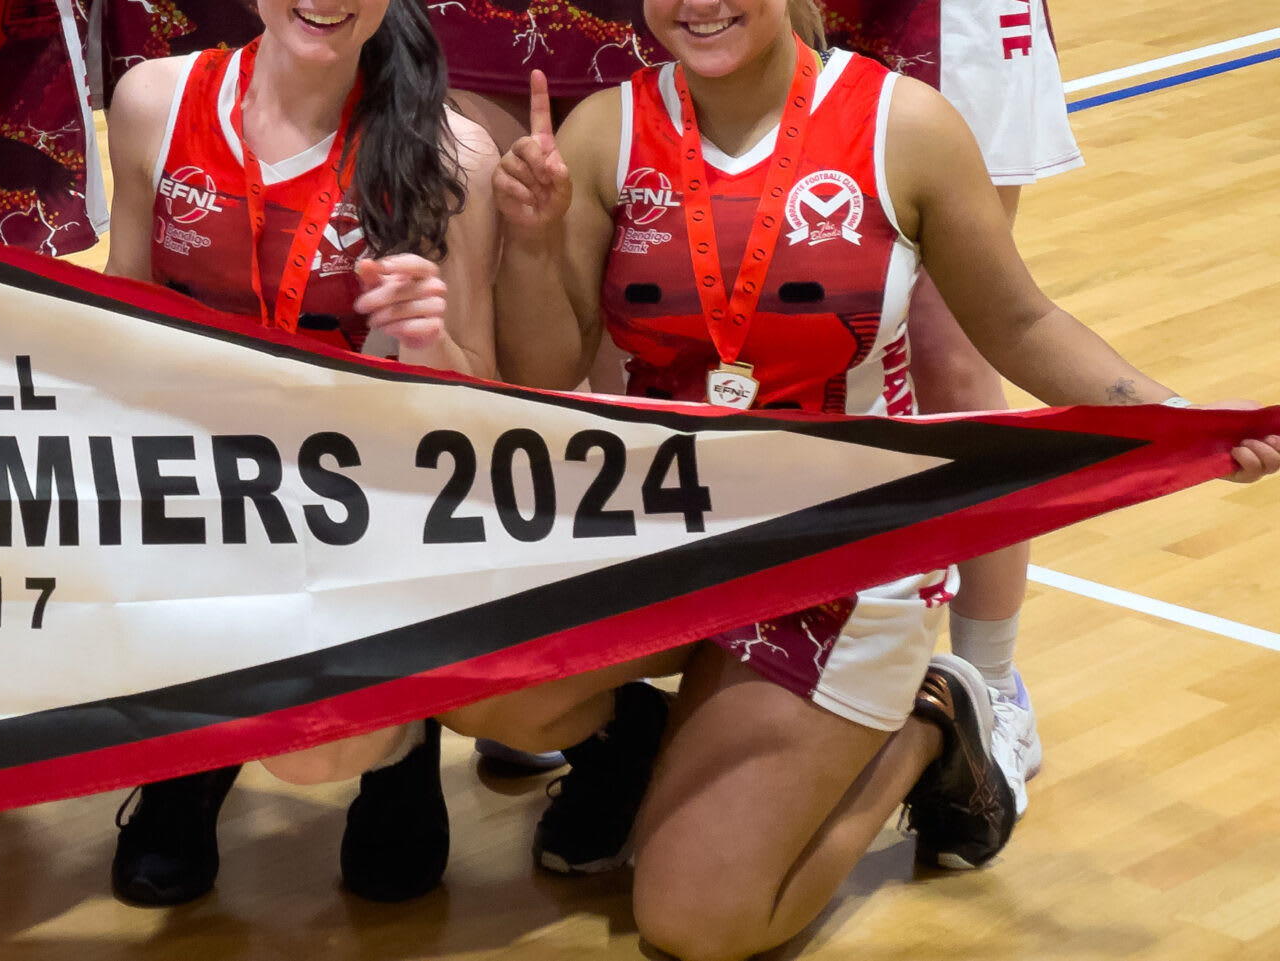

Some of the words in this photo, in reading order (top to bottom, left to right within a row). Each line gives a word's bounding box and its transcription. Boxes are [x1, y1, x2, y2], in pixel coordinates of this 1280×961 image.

[805, 173, 841, 185] FOOTBALL
[842, 178, 857, 194] CLUB
[160, 178, 223, 213] EFNL
[618, 188, 681, 207] EFNL
[810, 228, 841, 240] Bloods
[816, 221, 835, 231] The
[625, 228, 672, 245] Bendigo
[621, 240, 649, 254] Bank
[714, 384, 749, 399] EFNL
[415, 427, 712, 544] 2024
[25, 576, 57, 630] 7
